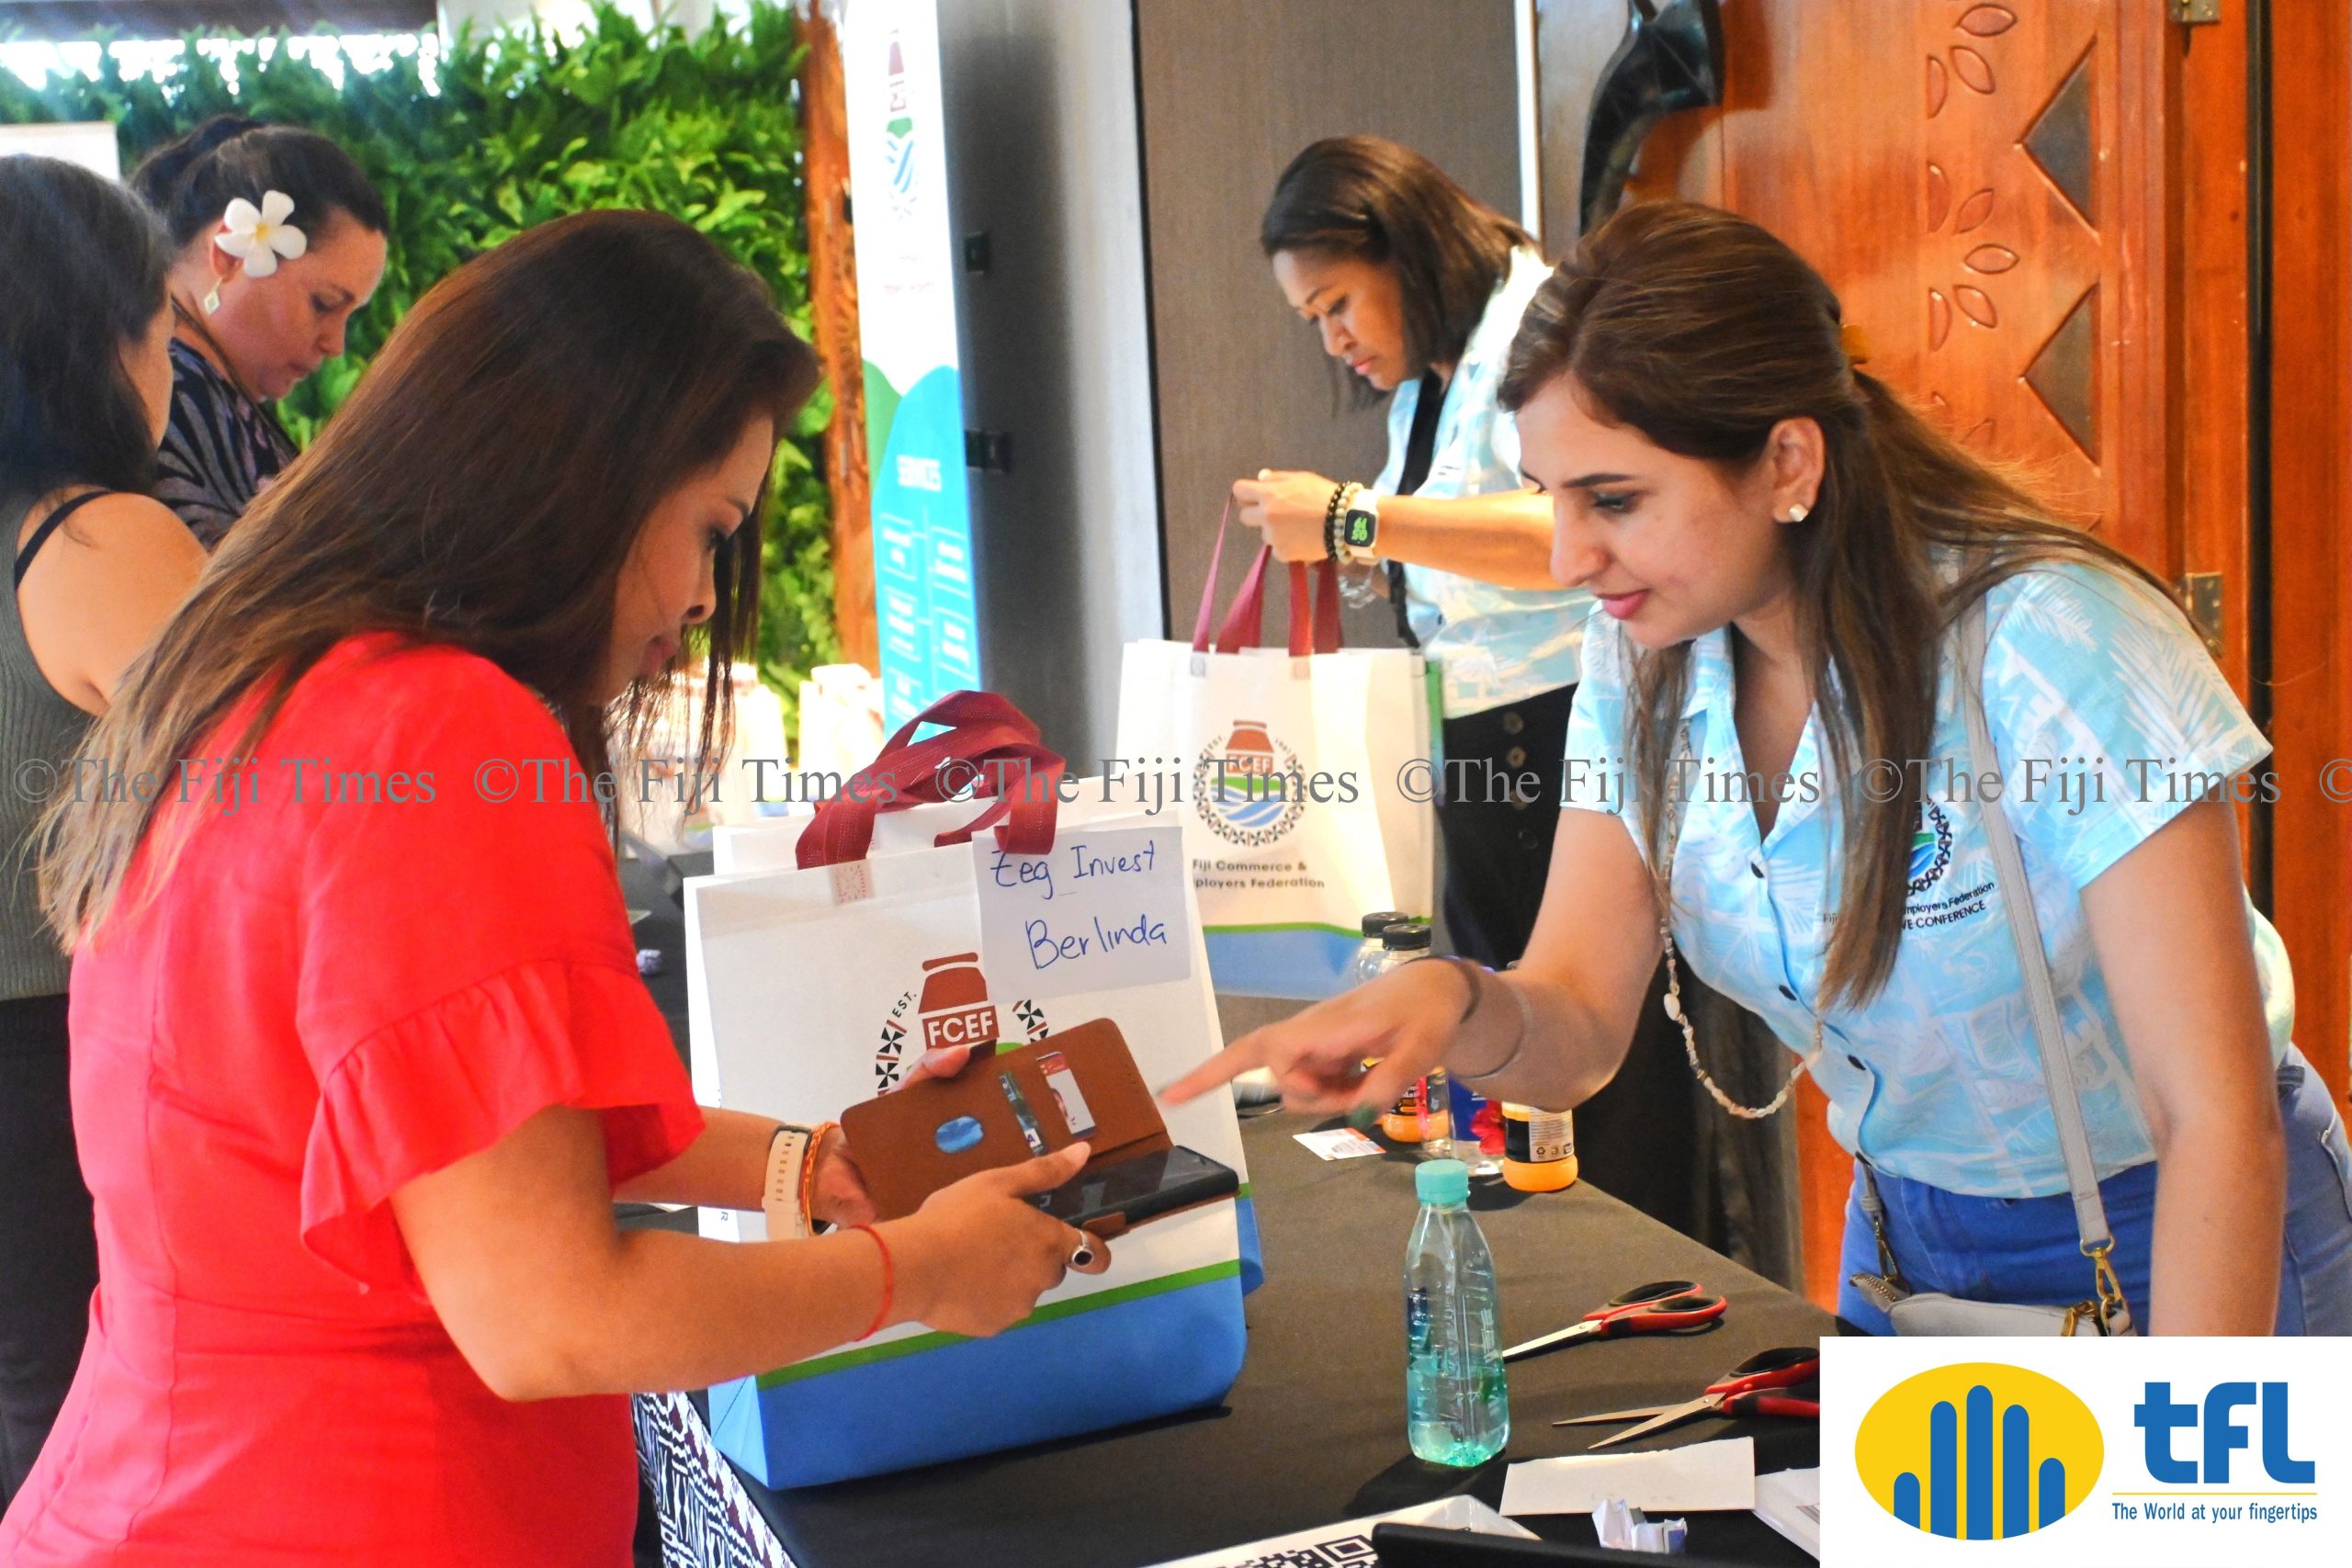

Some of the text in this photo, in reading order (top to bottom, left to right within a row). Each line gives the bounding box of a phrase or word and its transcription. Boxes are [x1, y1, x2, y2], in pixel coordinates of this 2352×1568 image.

[1070, 840, 1155, 878] Invest
[1193, 859, 1211, 872] Fiji
[1216, 860, 1293, 872] Commerce
[1194, 878, 1325, 889] ployers Federation
[1948, 882, 1995, 908] Federation
[1916, 899, 1986, 929] CONFERENCE
[1025, 914, 1167, 970] Berlinda
[891, 991, 918, 1019] EST.
[927, 1010, 995, 1047] FCEF
